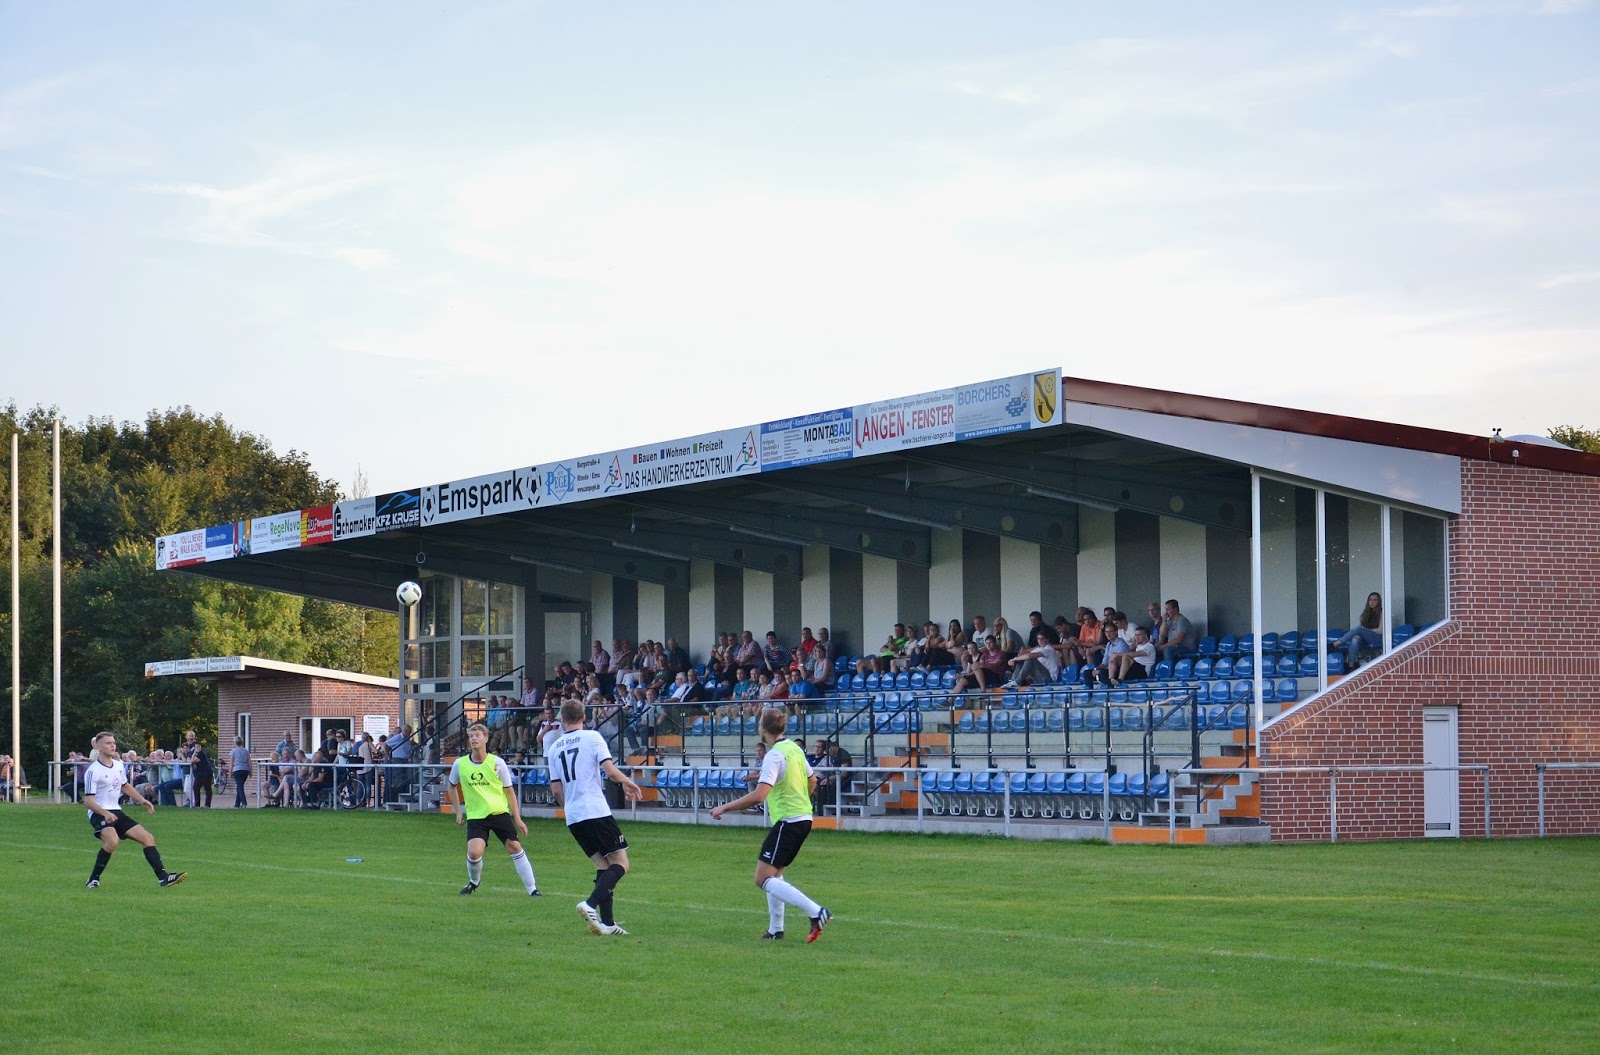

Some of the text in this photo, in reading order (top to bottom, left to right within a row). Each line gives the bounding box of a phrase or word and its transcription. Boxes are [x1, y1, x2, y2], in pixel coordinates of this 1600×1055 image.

[903, 400, 915, 409] gegen
[958, 383, 1010, 406] BORCHERS
[803, 421, 851, 443] MONTABAU
[855, 410, 905, 449] LANGEN
[912, 404, 954, 430] FENSTER
[638, 439, 724, 464] Bauen Wohnen Freizeit
[828, 436, 851, 445] TECHNIK
[625, 455, 733, 490] DAS HANDWERKERZENTRUM
[438, 470, 524, 515] Emspark
[335, 513, 375, 537] Schomaker
[376, 513, 391, 528] KFZ
[392, 509, 420, 526] KRUSE
[558, 747, 580, 783] 17
